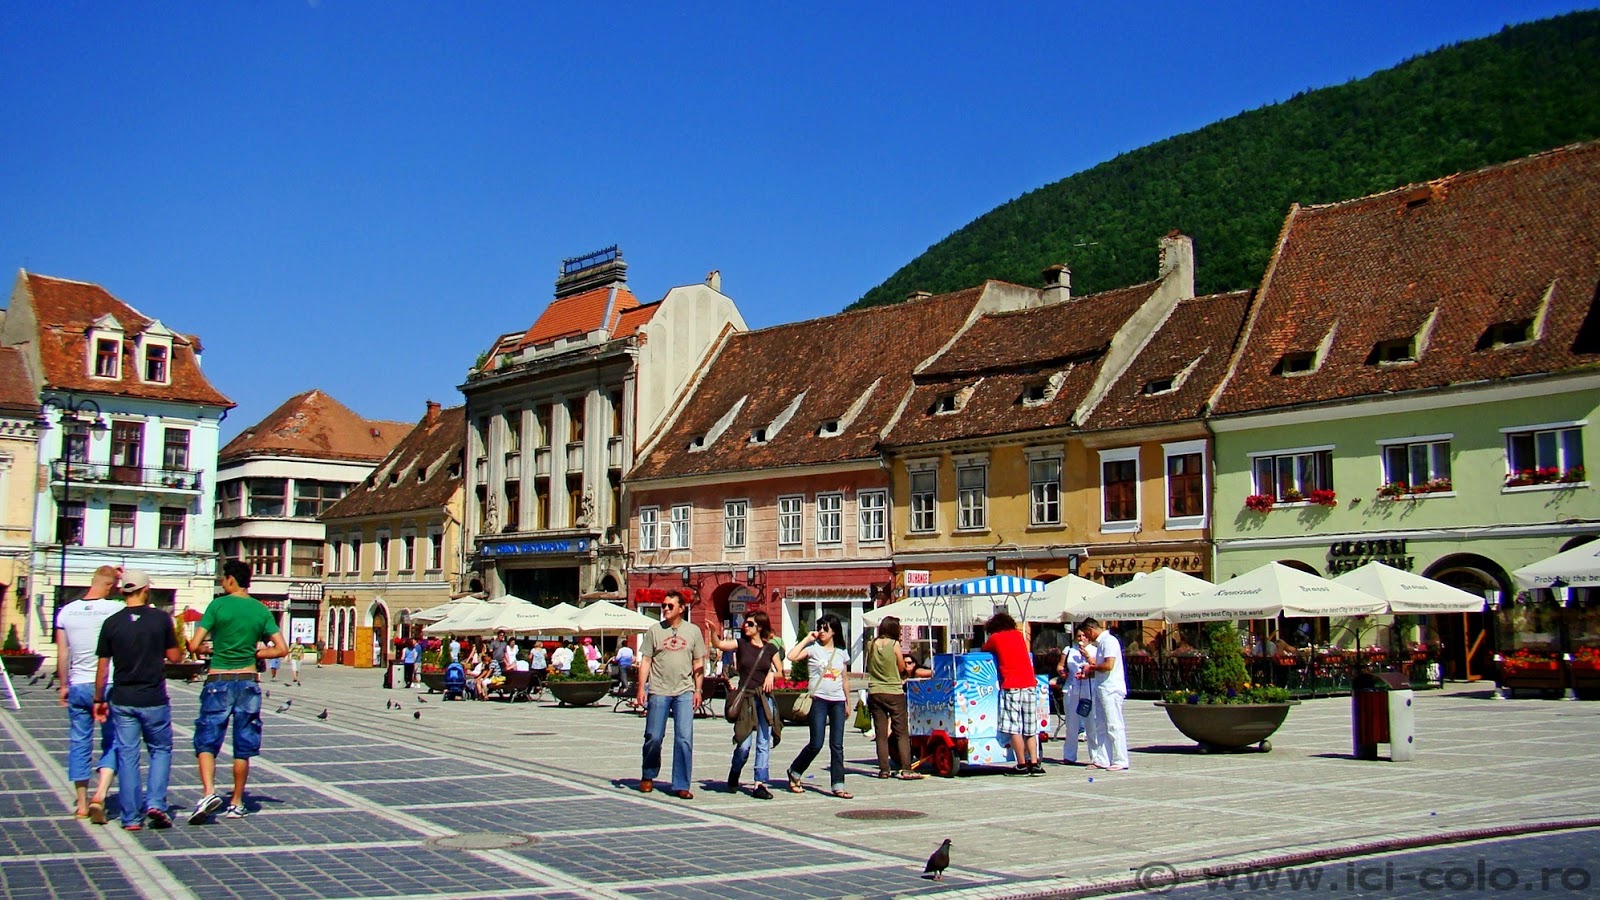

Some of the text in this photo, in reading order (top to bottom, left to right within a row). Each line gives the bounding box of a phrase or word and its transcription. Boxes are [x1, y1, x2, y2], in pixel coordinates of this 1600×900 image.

[1102, 558, 1136, 572] LOTO
[1328, 556, 1414, 574] RESTANT
[907, 573, 928, 584] EXCHANGE
[1534, 574, 1600, 583] Probbly the be
